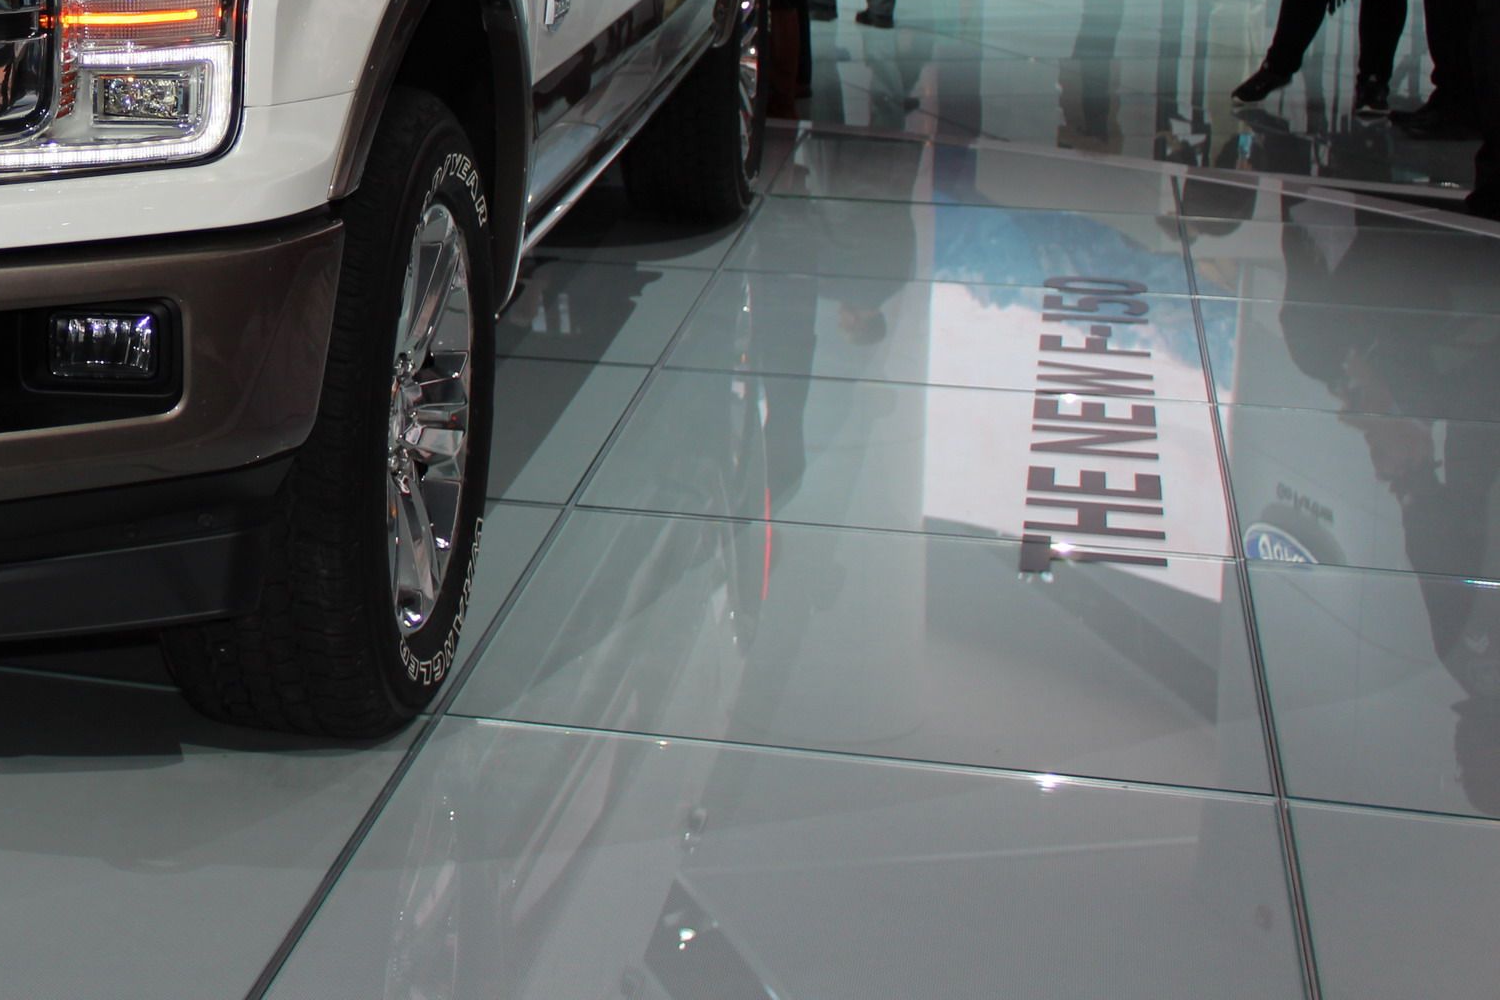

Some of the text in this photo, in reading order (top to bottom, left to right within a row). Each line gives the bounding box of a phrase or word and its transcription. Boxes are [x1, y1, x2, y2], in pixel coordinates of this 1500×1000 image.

[1018, 275, 1168, 573] THE NEW F-150
